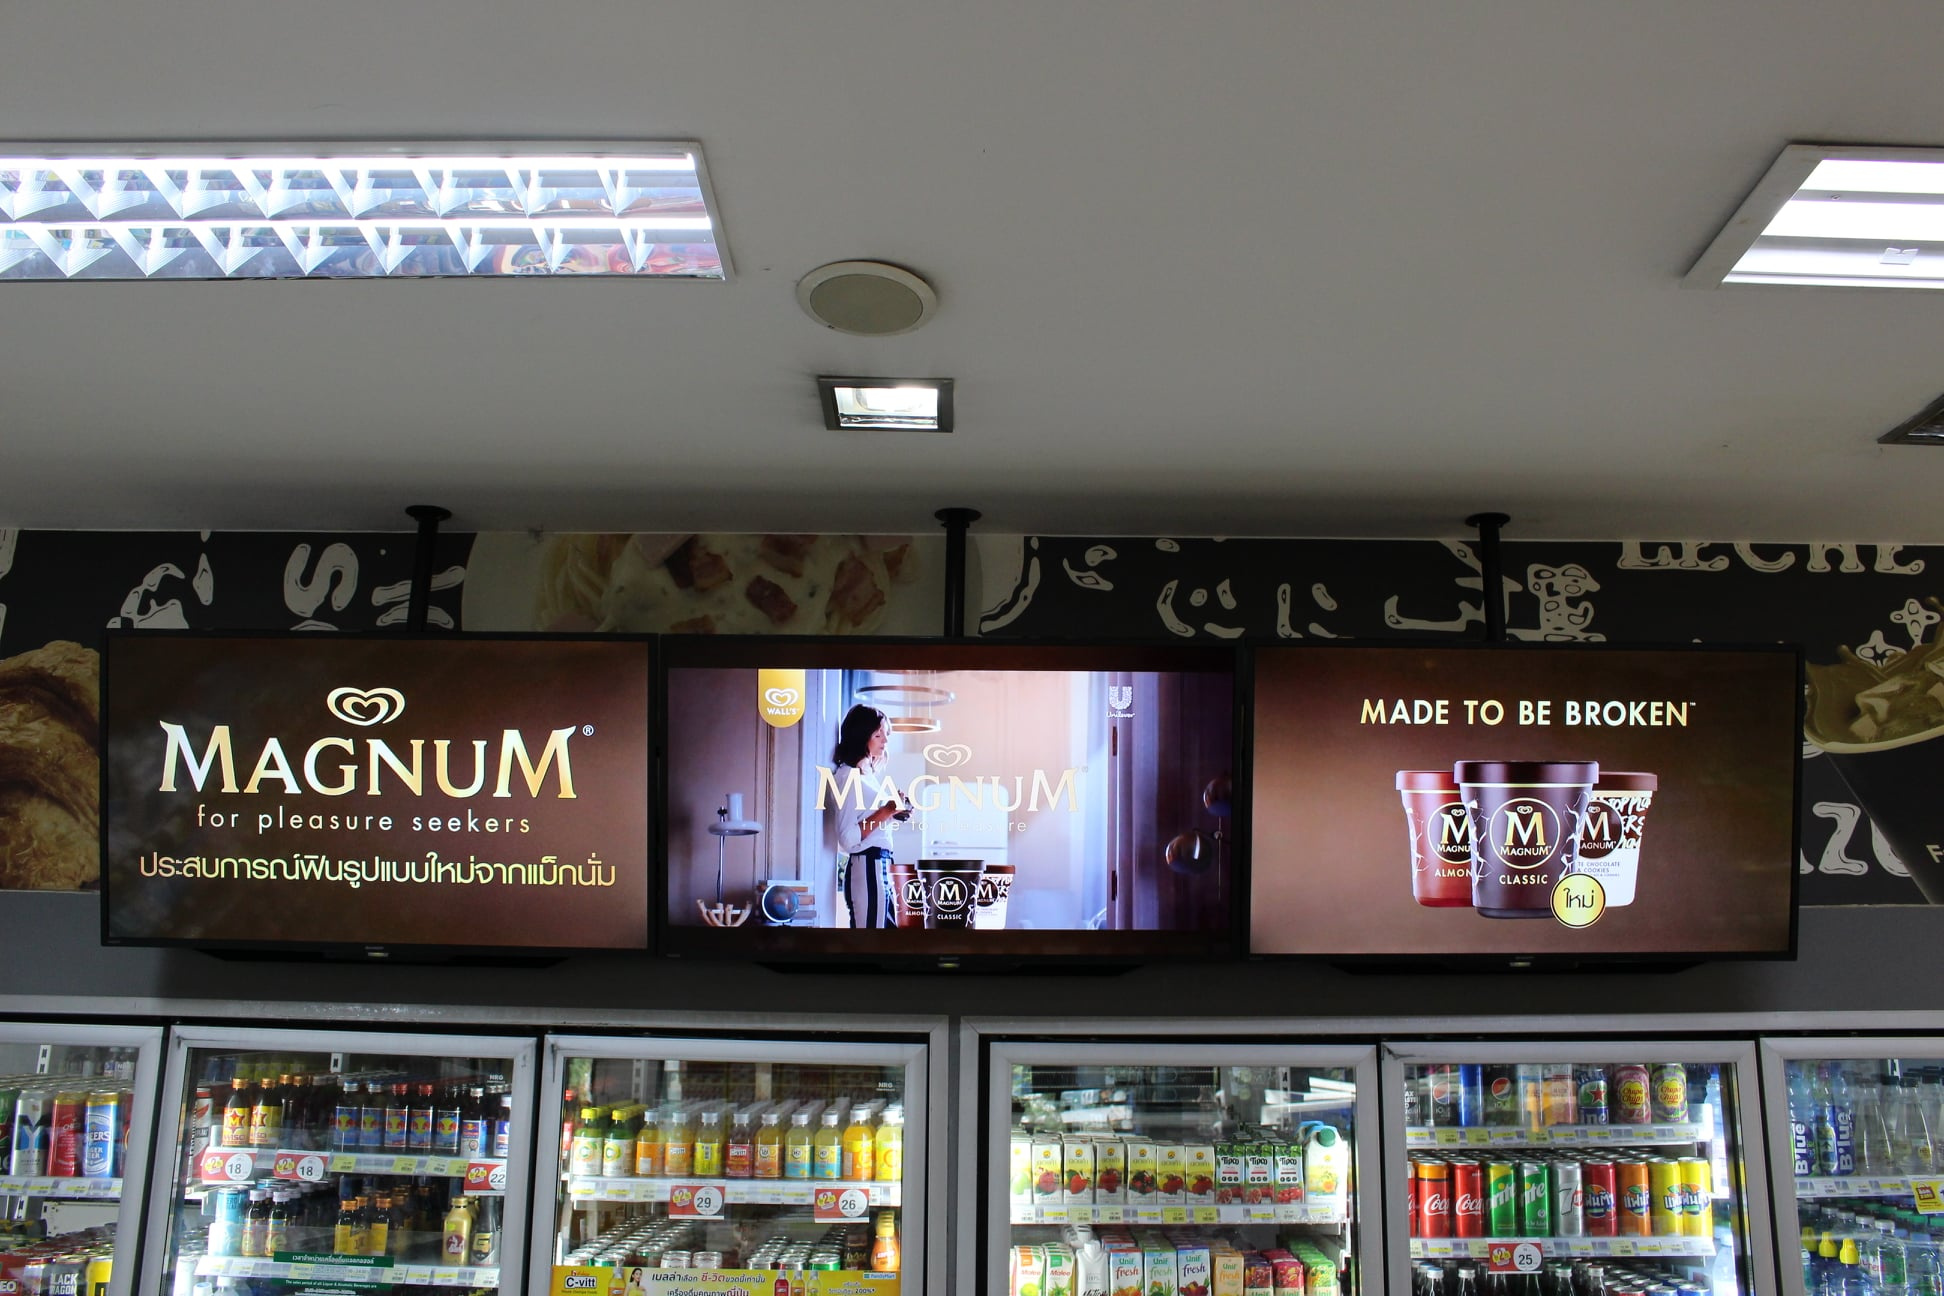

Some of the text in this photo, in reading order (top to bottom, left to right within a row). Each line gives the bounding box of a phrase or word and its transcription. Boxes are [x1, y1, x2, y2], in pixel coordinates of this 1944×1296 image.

[766, 707, 798, 715] WALL'S
[1360, 699, 1449, 725] MADE
[1463, 700, 1505, 725] TO
[1519, 700, 1551, 726] BE
[159, 720, 578, 799] MAGNUM
[813, 765, 1079, 812] MAGNUM
[197, 804, 531, 834] for pleasure seekers
[862, 818, 901, 832] true
[910, 820, 929, 832] to
[1437, 843, 1473, 853] MAGNU
[1500, 845, 1550, 857] MAGNUM
[1578, 840, 1615, 850] AGNUM
[1434, 868, 1473, 878] ALMON
[1499, 874, 1548, 885] CLASSIC
[228, 1162, 242, 1175] 18
[299, 1166, 313, 1177] 18
[490, 1173, 506, 1184] 22
[697, 1197, 712, 1209] 29
[841, 1199, 856, 1210] 26
[1518, 1254, 1533, 1266] 25
[1115, 1266, 1139, 1280] fresh
[1183, 1263, 1206, 1277] fresh
[0, 1281, 17, 1292] EO
[566, 1277, 596, 1288] C-vitt
